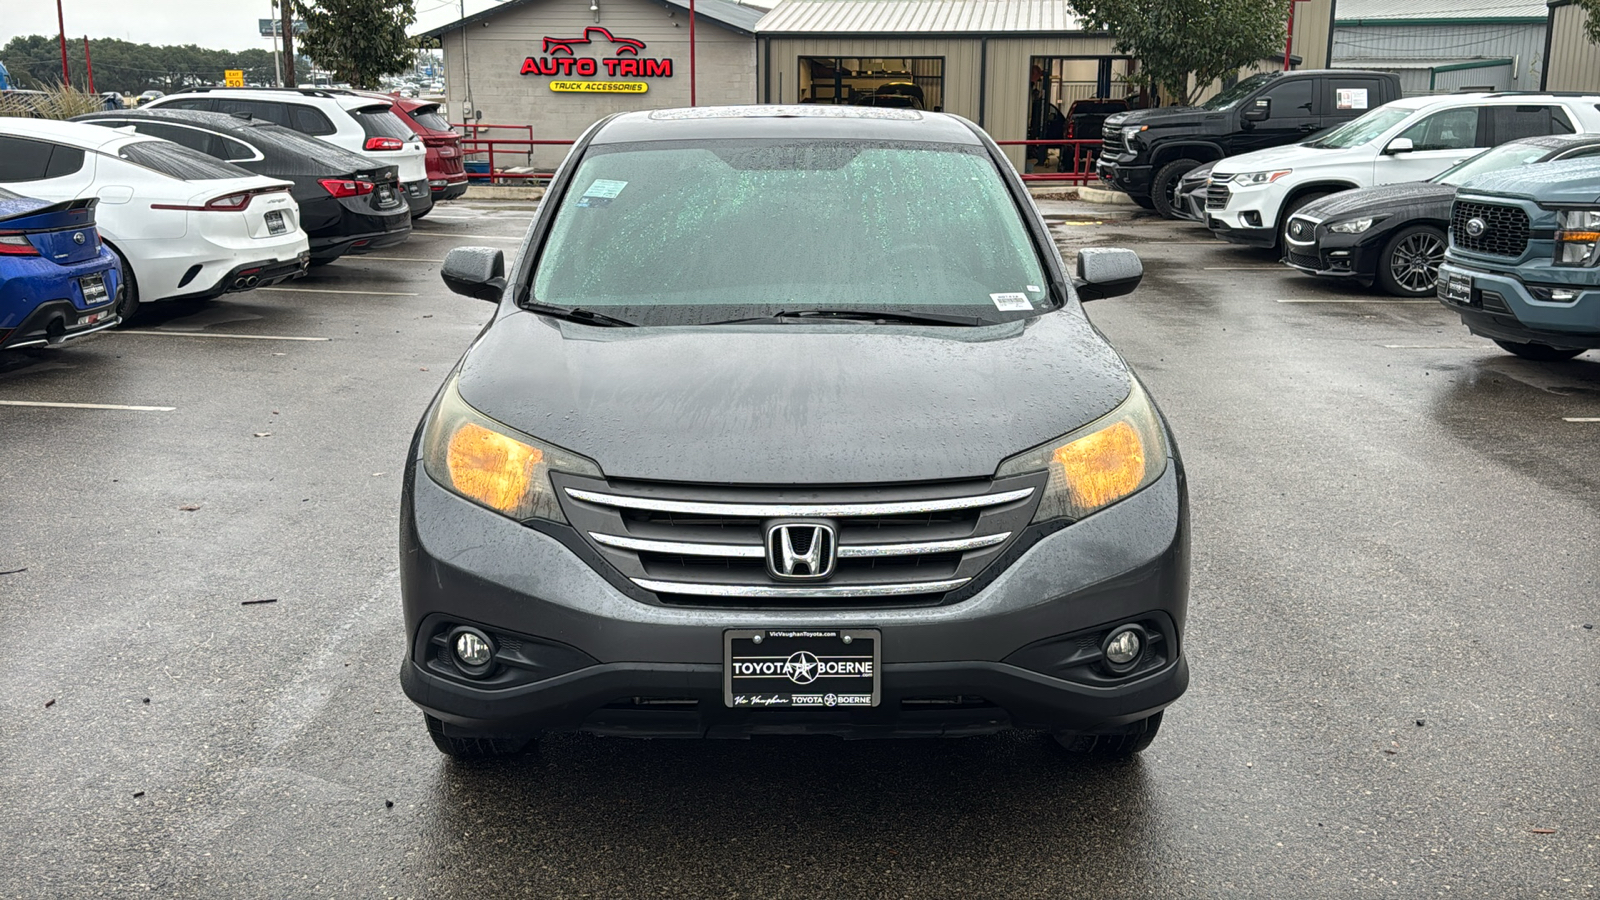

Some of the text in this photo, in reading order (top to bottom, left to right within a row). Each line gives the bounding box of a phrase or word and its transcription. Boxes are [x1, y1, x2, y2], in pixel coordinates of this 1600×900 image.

[520, 56, 673, 77] AUTO TRIM
[554, 82, 643, 91] TRUCK ACCESSORIES
[733, 662, 794, 674] TOYOTA
[818, 661, 873, 674] BOERNE
[792, 696, 823, 704] TOYOTA
[838, 696, 871, 704] BOERNE
